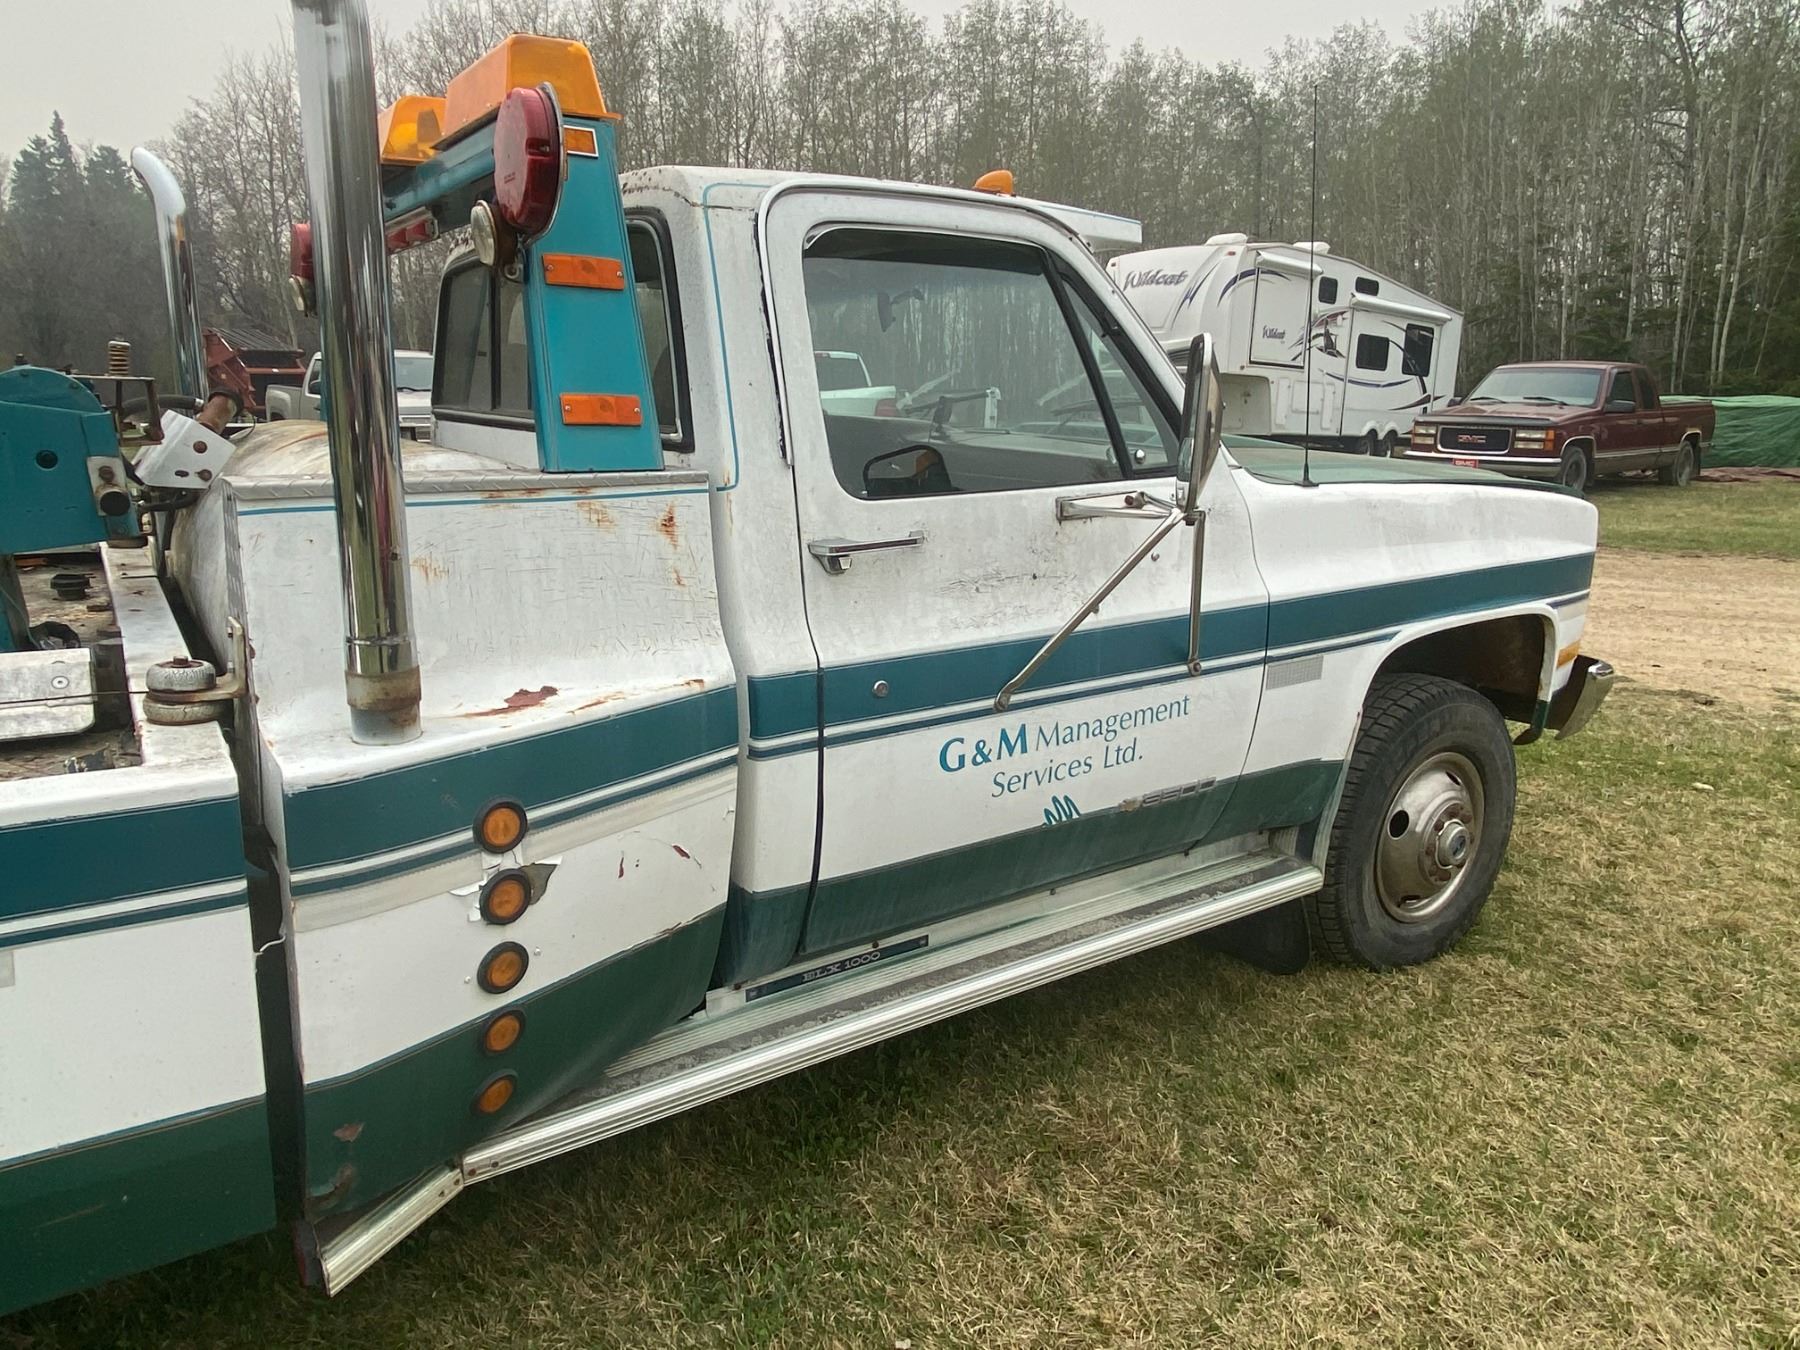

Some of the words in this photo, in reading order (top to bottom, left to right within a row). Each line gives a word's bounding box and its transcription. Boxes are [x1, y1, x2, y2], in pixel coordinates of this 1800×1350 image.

[1123, 269, 1188, 292] Wildcat
[1457, 434, 1487, 443] GMC
[1035, 694, 1190, 752] Management
[991, 754, 1093, 798] Services
[1103, 738, 1143, 769] Ltd.
[844, 951, 881, 970] 1000
